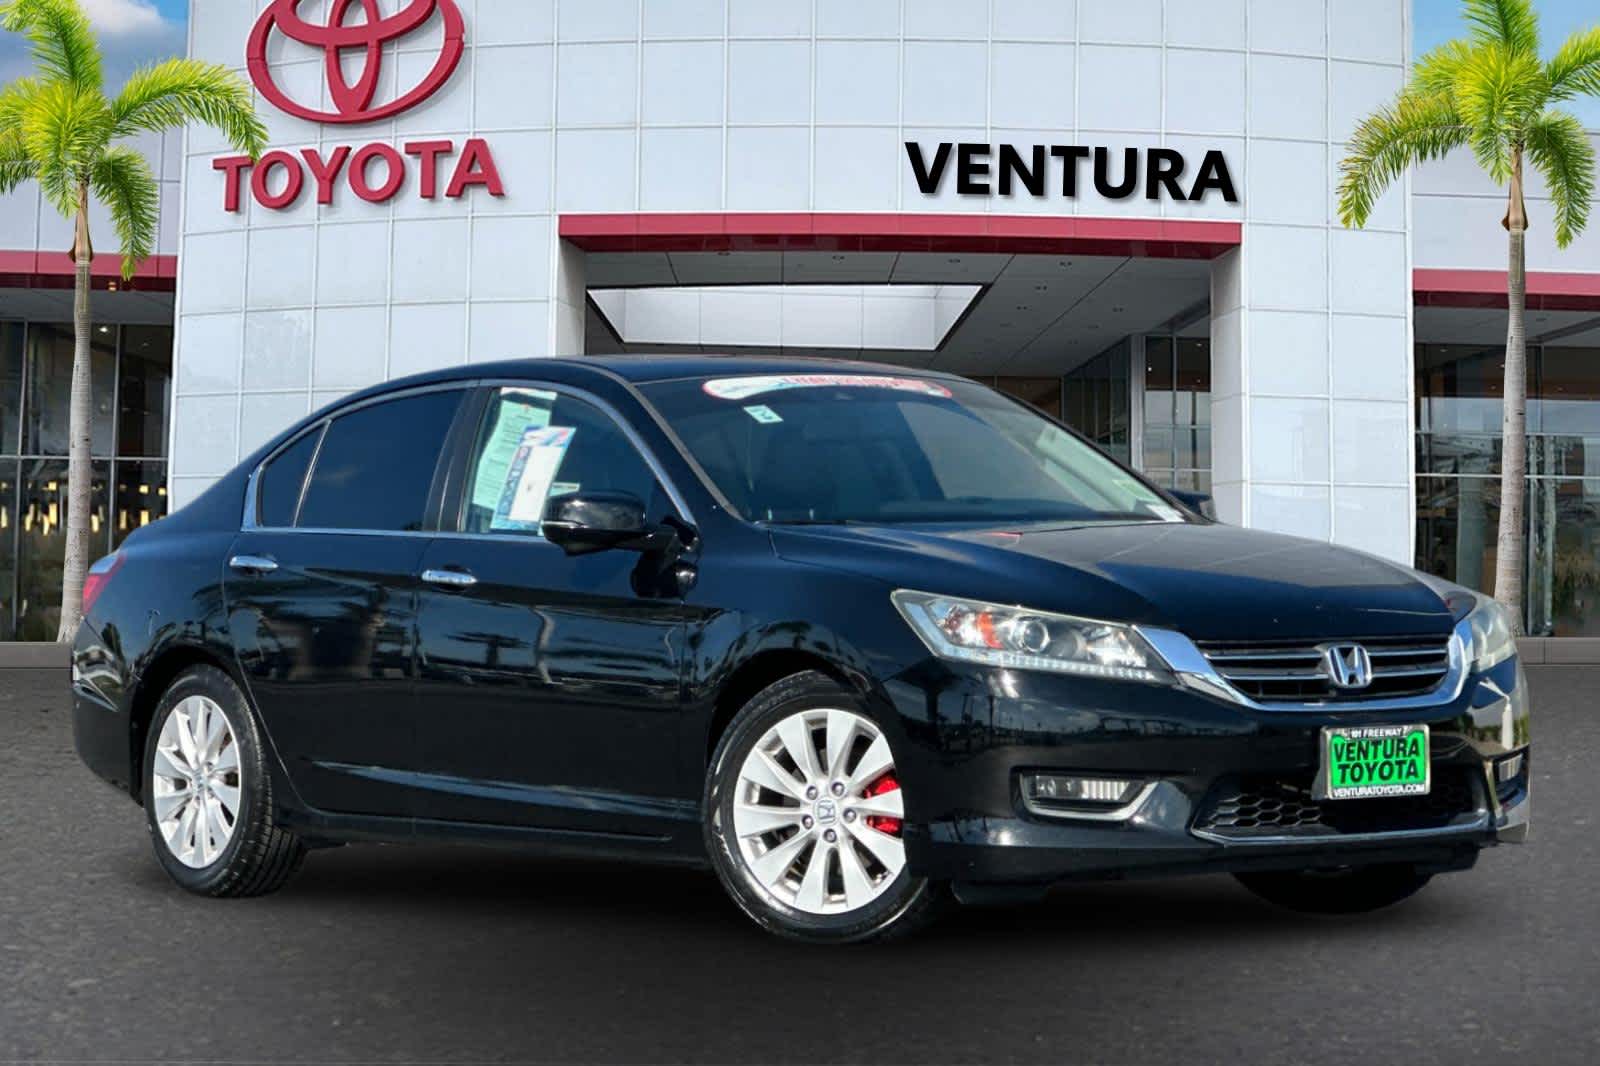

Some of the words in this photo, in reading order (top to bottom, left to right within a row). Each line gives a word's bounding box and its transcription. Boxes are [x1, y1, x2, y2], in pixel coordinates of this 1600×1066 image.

[213, 138, 505, 212] TOYOTA
[905, 142, 1238, 203] VENTURA
[1333, 738, 1419, 762] VENTURA
[1338, 759, 1418, 784] TOYOTA
